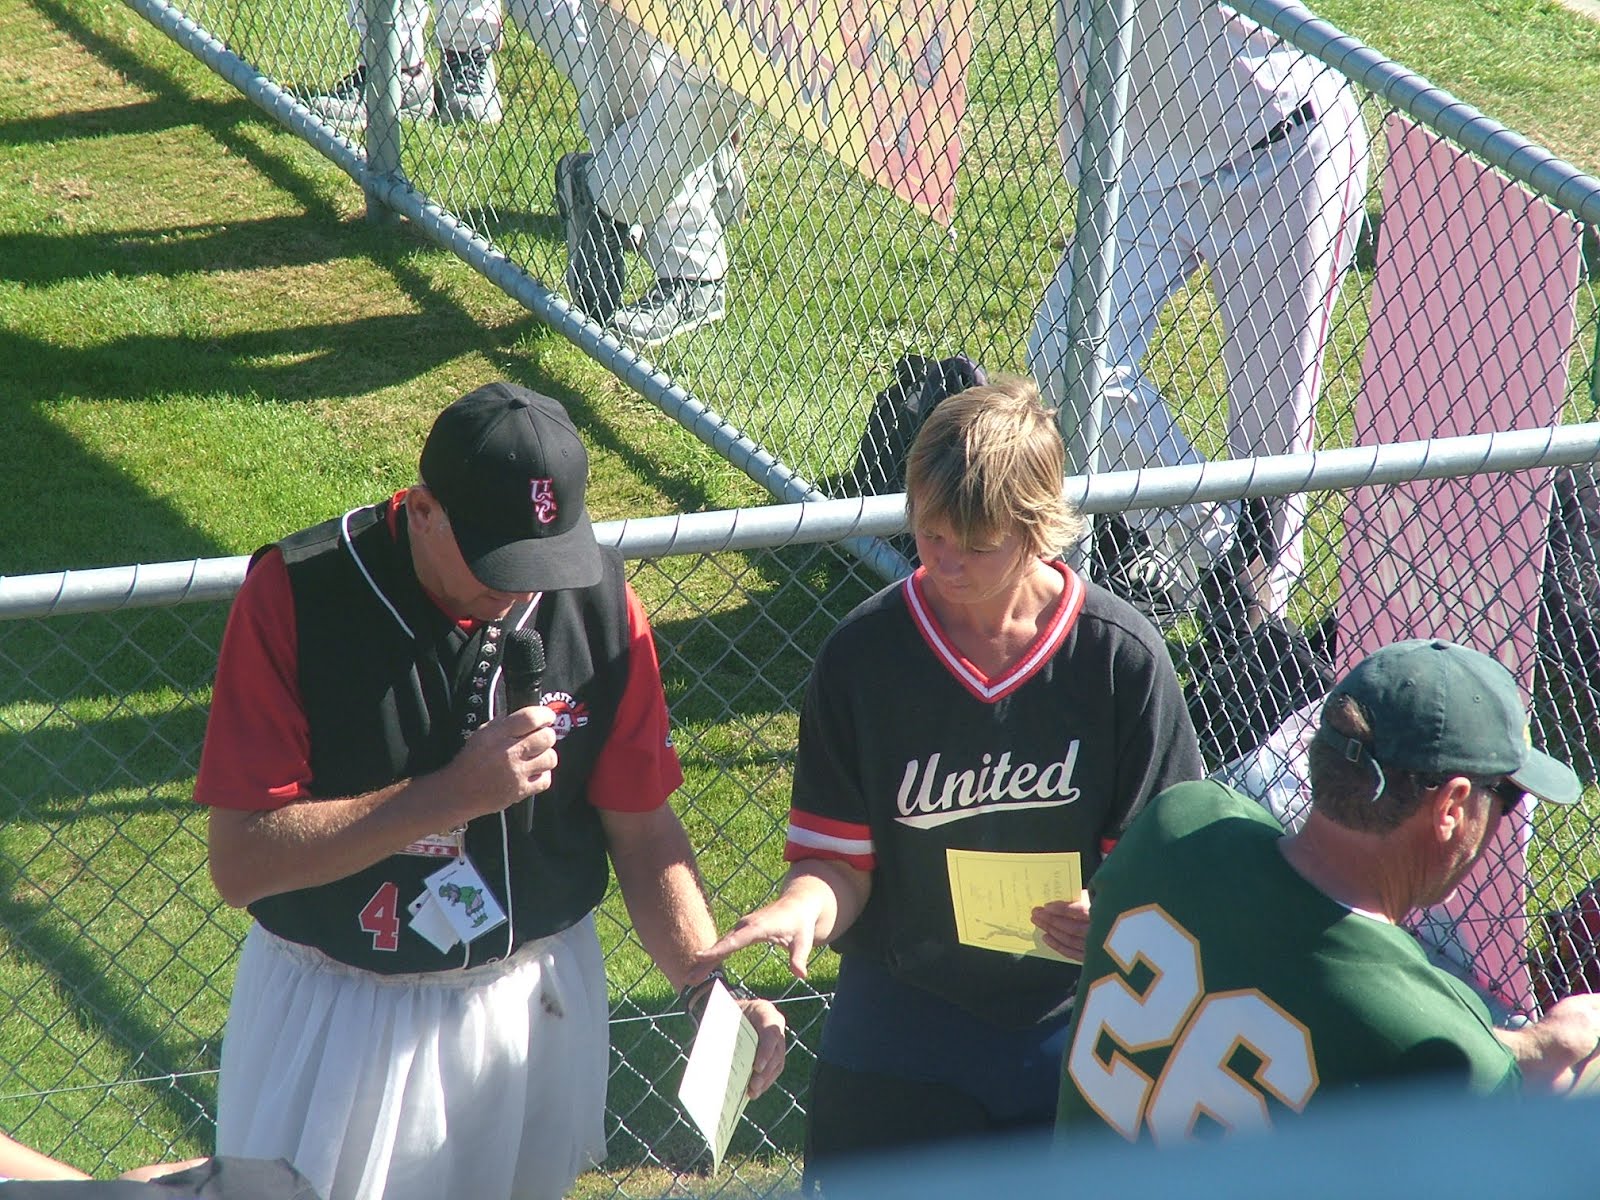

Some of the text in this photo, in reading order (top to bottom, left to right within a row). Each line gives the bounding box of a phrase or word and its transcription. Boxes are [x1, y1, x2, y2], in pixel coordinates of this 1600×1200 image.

[895, 739, 1081, 822] United
[358, 881, 400, 952] 4
[1068, 903, 1320, 1150] 26
